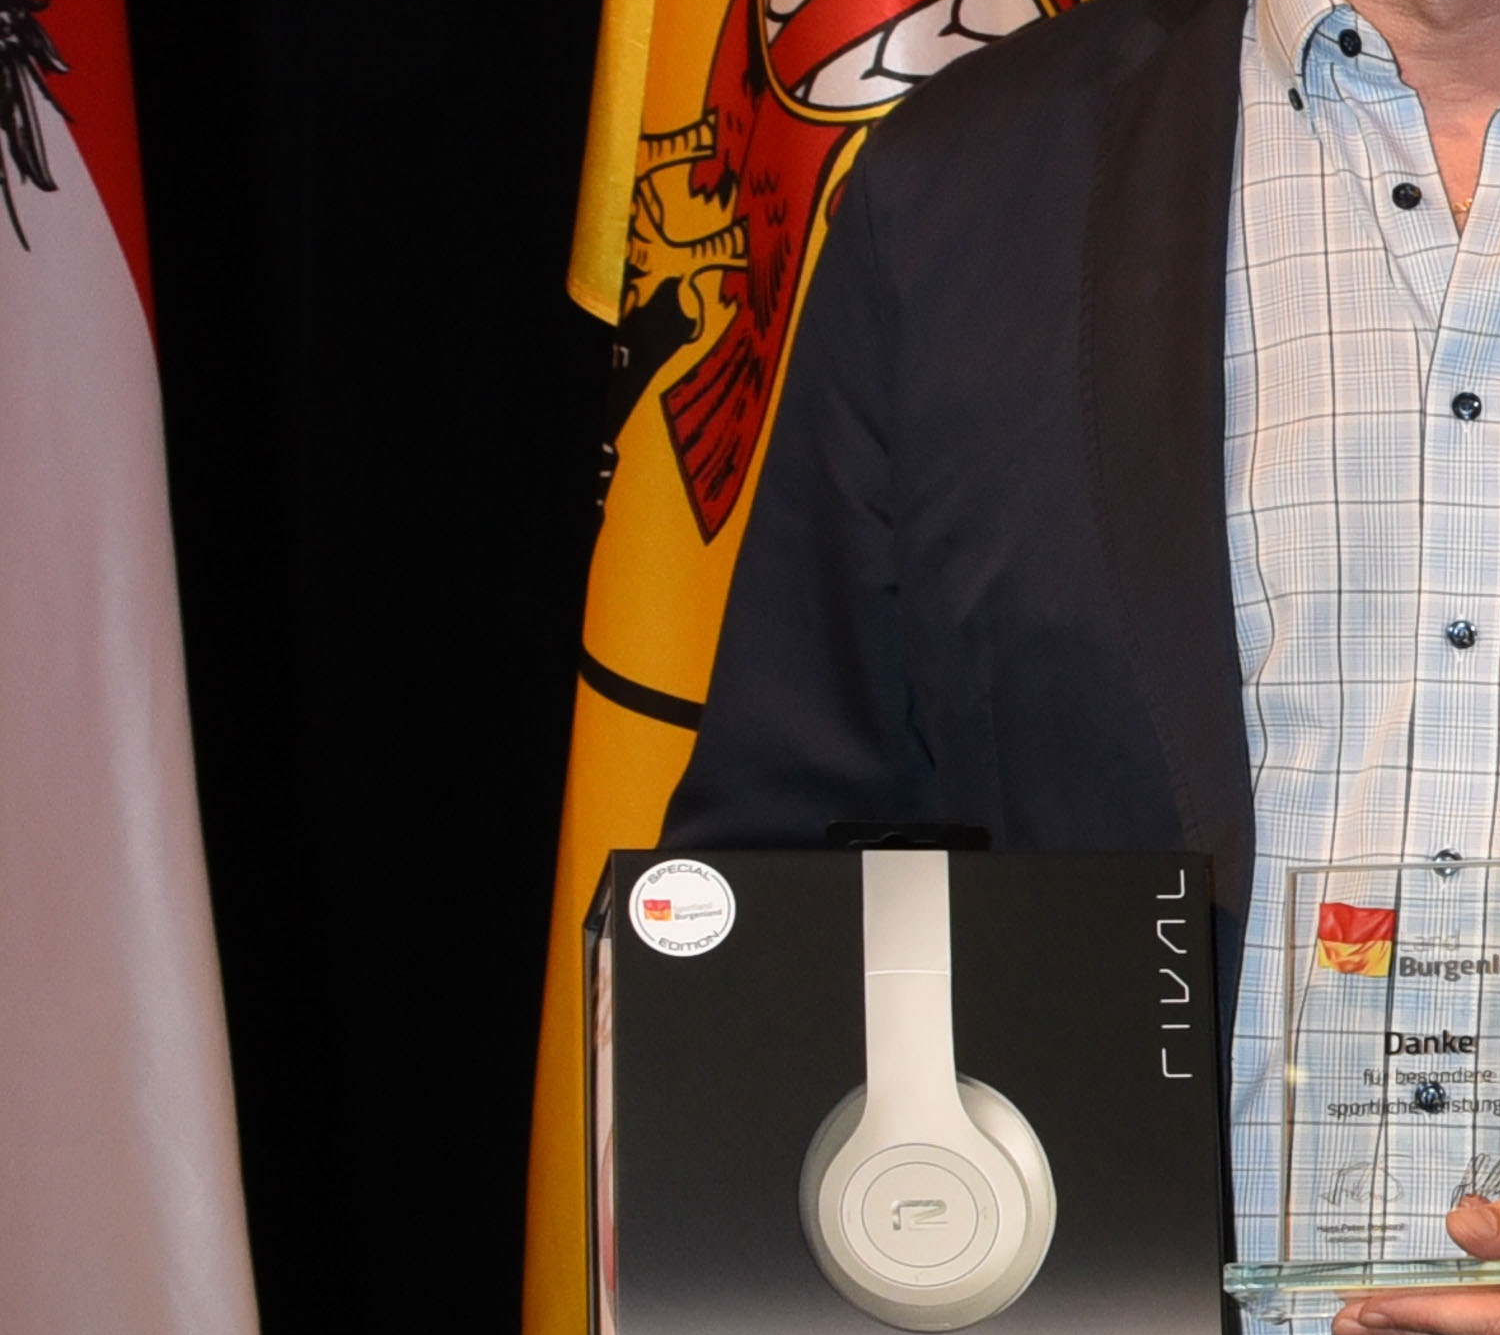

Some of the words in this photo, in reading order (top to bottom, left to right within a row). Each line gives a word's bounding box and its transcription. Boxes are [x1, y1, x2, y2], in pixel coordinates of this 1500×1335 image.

[646, 863, 710, 884] SPECIAL
[657, 930, 721, 951] EDITION
[1384, 1029, 1477, 1057] Danke
[1395, 1067, 1494, 1086] besondere
[1327, 1097, 1418, 1122] sportliche
